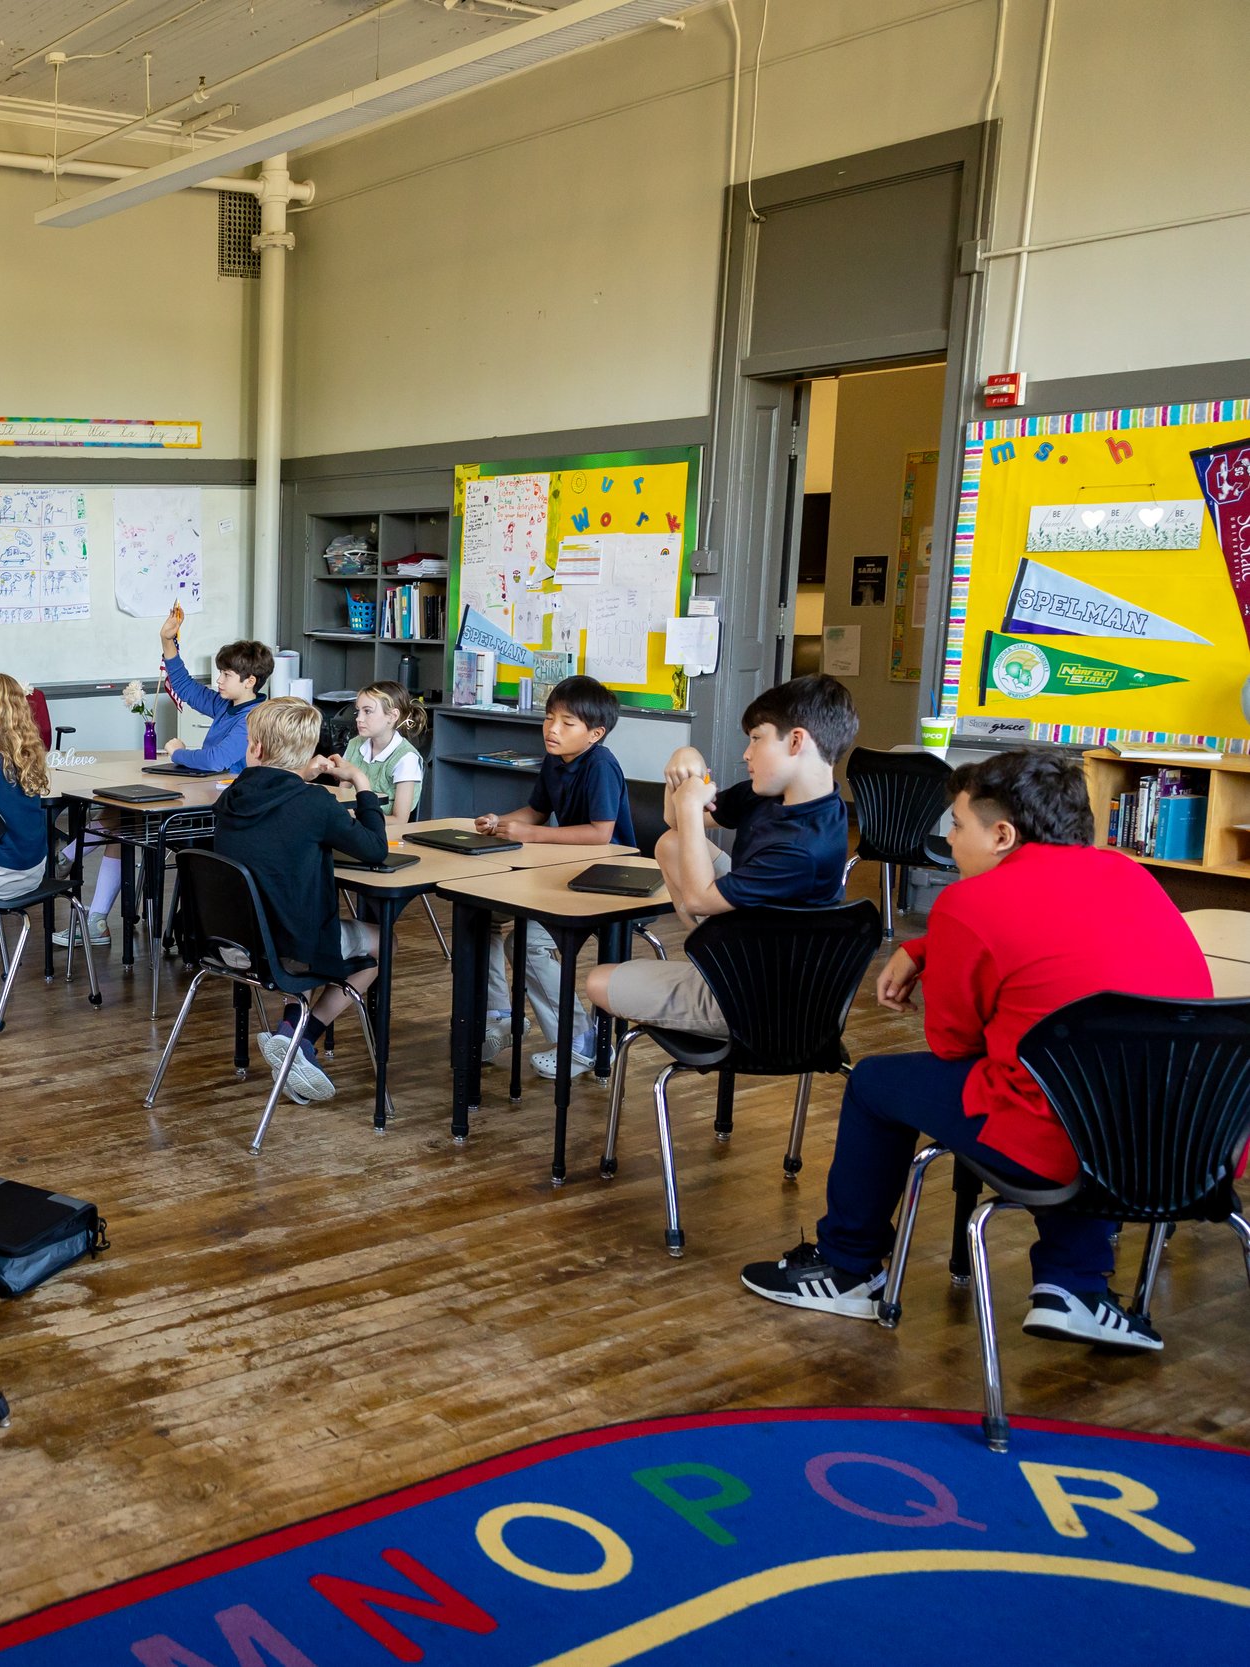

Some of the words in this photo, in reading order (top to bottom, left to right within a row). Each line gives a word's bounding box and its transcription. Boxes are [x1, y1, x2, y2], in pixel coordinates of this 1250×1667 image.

[994, 376, 1011, 384] FIRE
[1052, 510, 1060, 518] BE
[534, 659, 563, 667] ANCIENT
[535, 666, 563, 679] CHINA
[1061, 666, 1113, 677] NORFOLK
[1069, 675, 1108, 683] STATE
[968, 719, 989, 728] Show
[988, 722, 1025, 734] grace
[46, 747, 97, 767] Believe
[309, 1548, 499, 1664] N
[475, 1502, 634, 1592] O
[631, 1462, 751, 1547] P
[803, 1451, 989, 1532] Q
[1017, 1460, 1197, 1554] R
